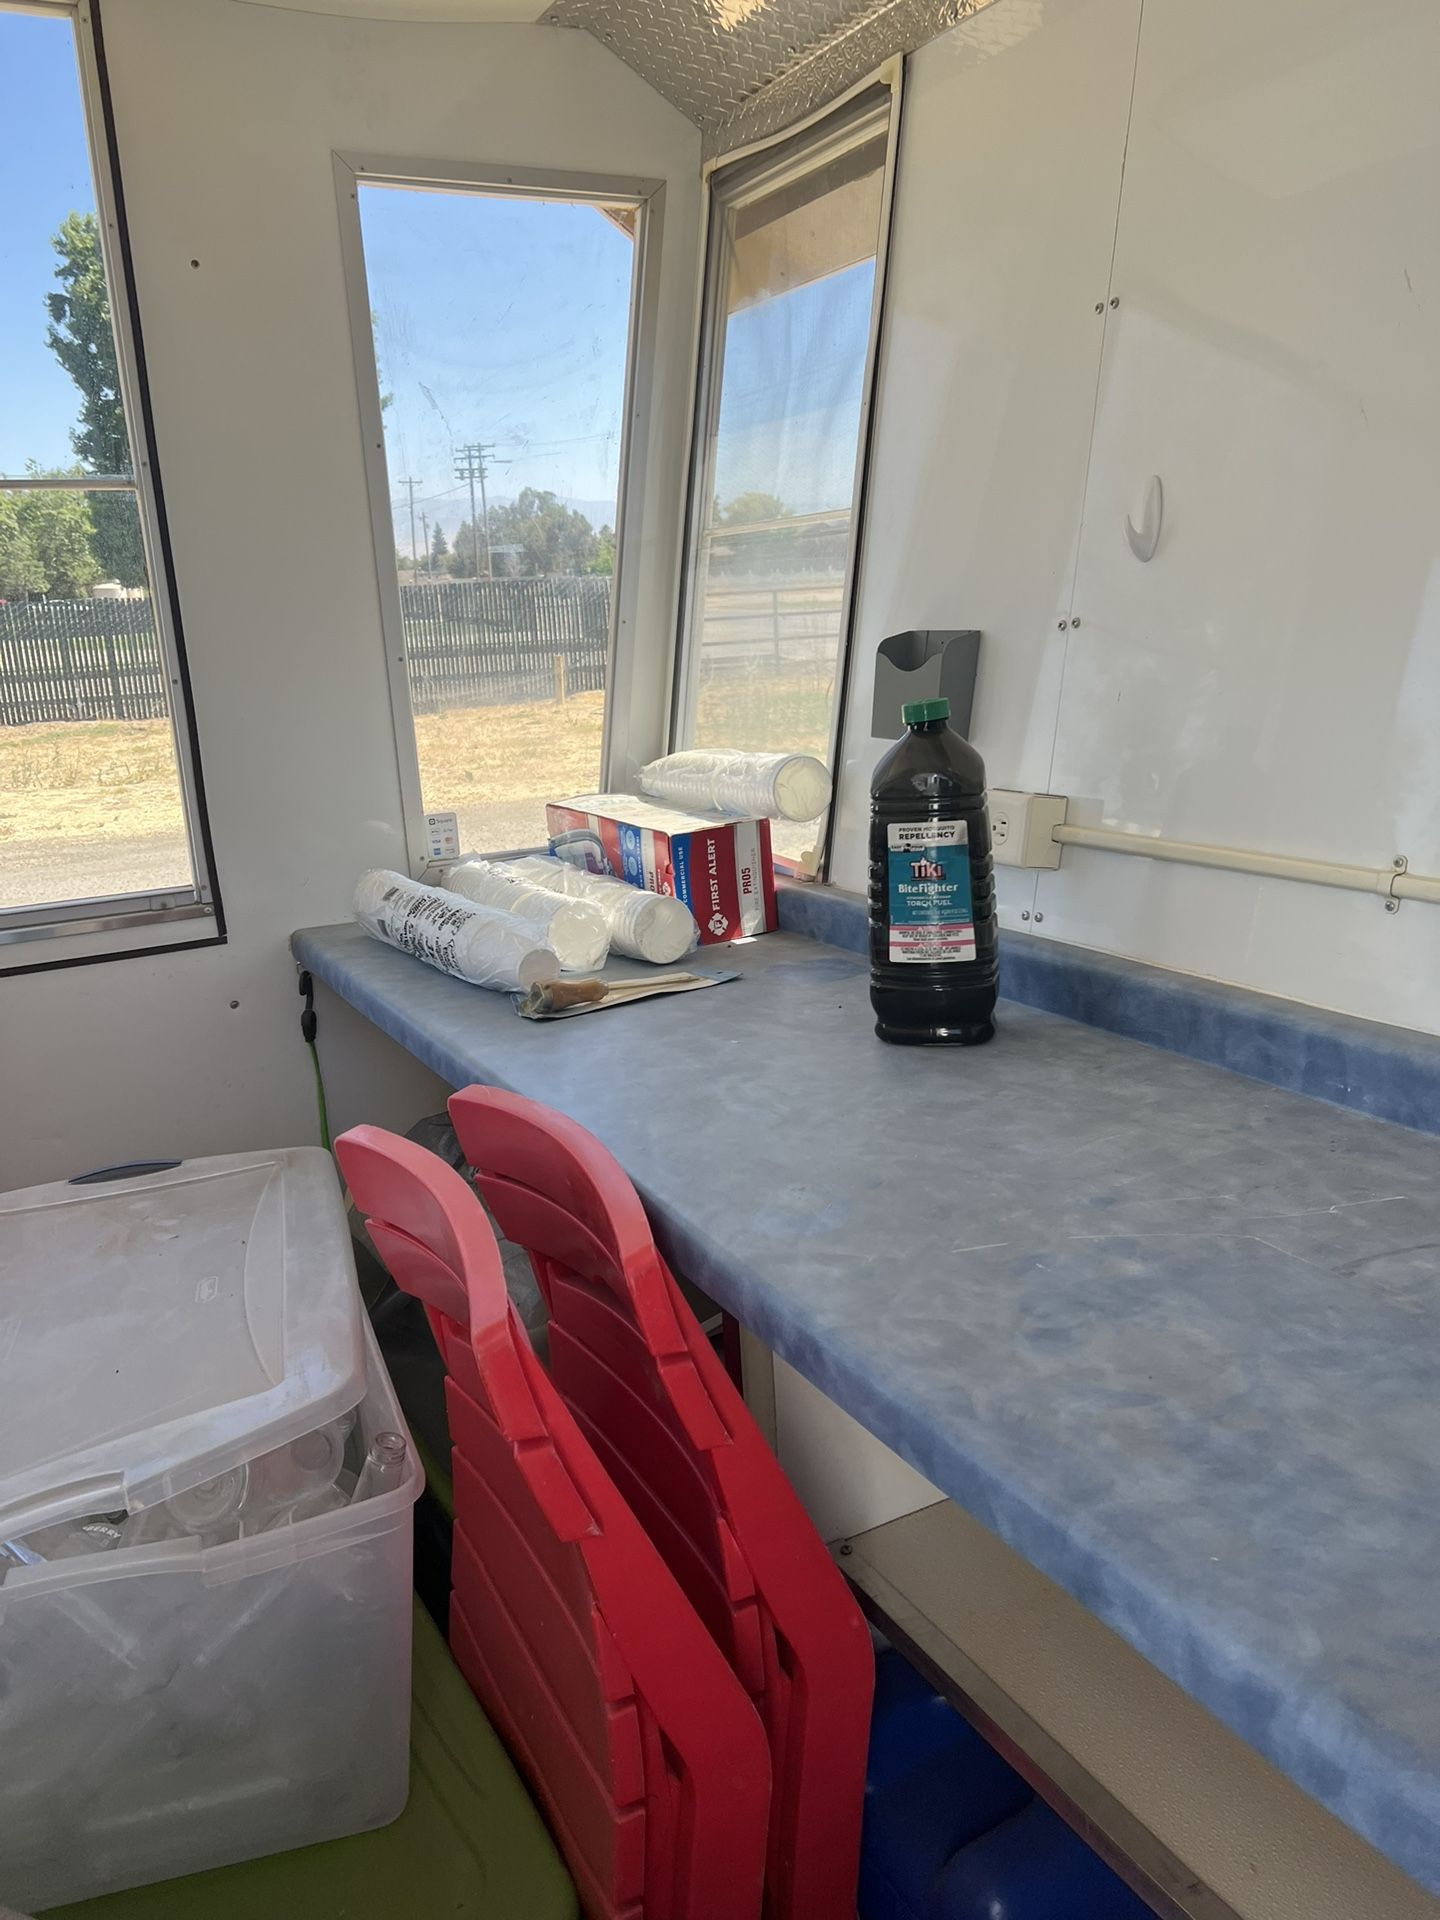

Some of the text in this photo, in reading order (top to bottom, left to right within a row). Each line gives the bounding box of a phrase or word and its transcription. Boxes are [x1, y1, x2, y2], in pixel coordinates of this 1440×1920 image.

[898, 831, 956, 840] REPELLENCY
[679, 861, 688, 902] COMMERCIAL
[707, 839, 720, 911] FIRST ALERT
[741, 867, 752, 894] PRO5
[82, 1525, 121, 1538] BERRY
